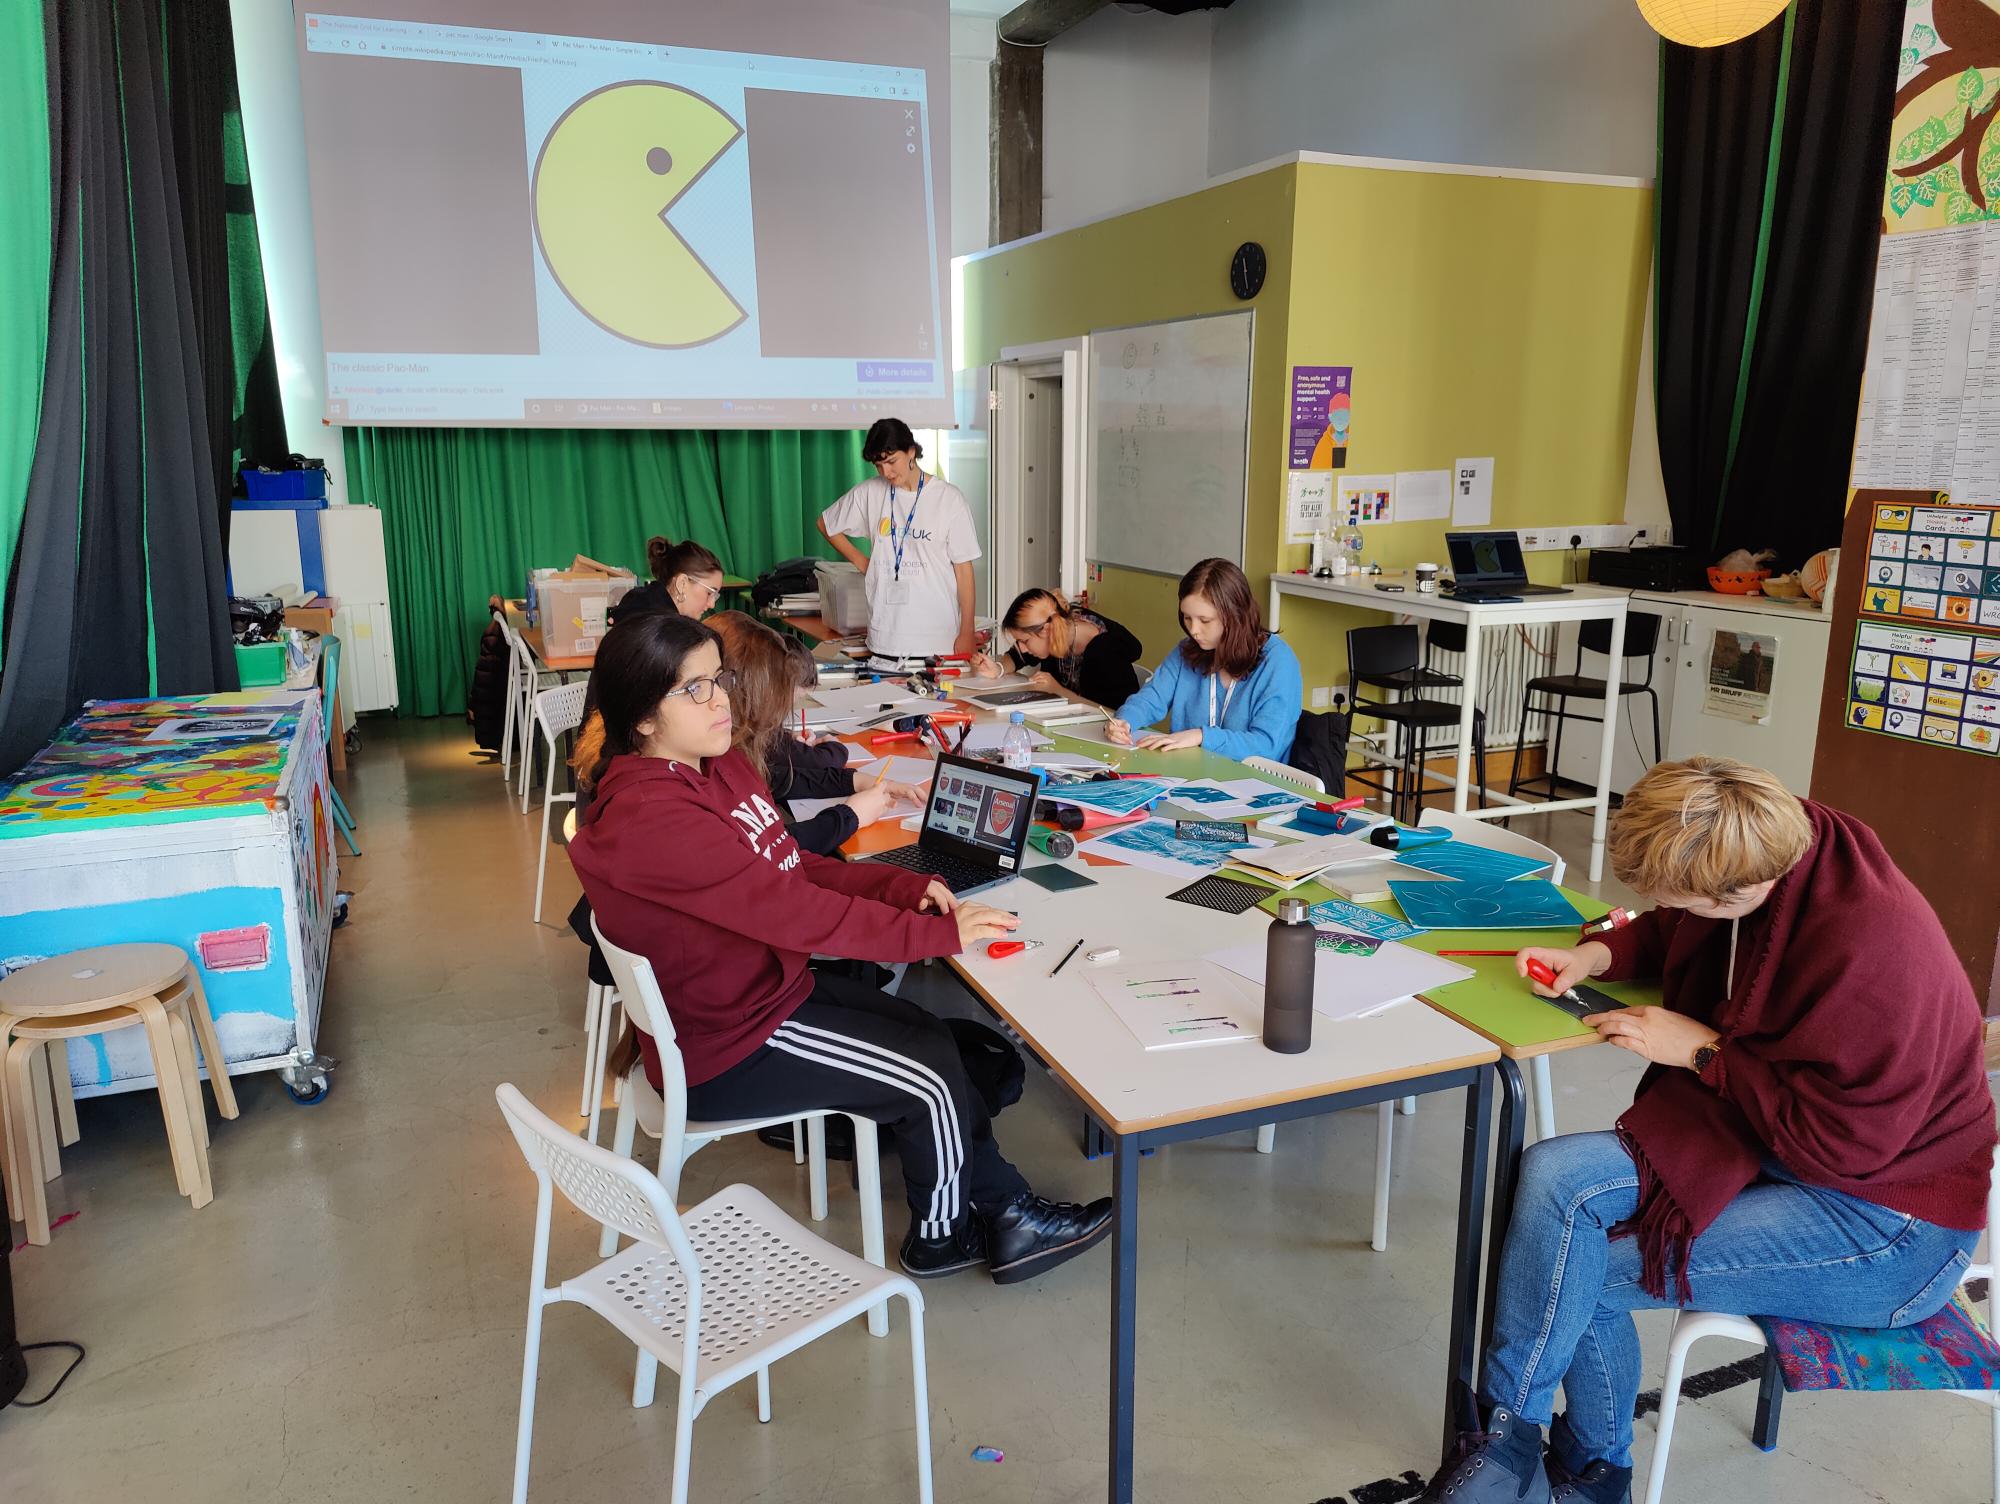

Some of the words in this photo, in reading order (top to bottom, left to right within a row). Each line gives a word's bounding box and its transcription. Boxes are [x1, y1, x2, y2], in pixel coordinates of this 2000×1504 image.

[332, 362, 350, 373] The
[352, 362, 385, 374] classic
[387, 363, 430, 374] Pac-Man
[878, 368, 898, 377] More
[900, 368, 928, 377] details
[912, 528, 932, 542] UK
[994, 798, 1014, 808] Arsenal
